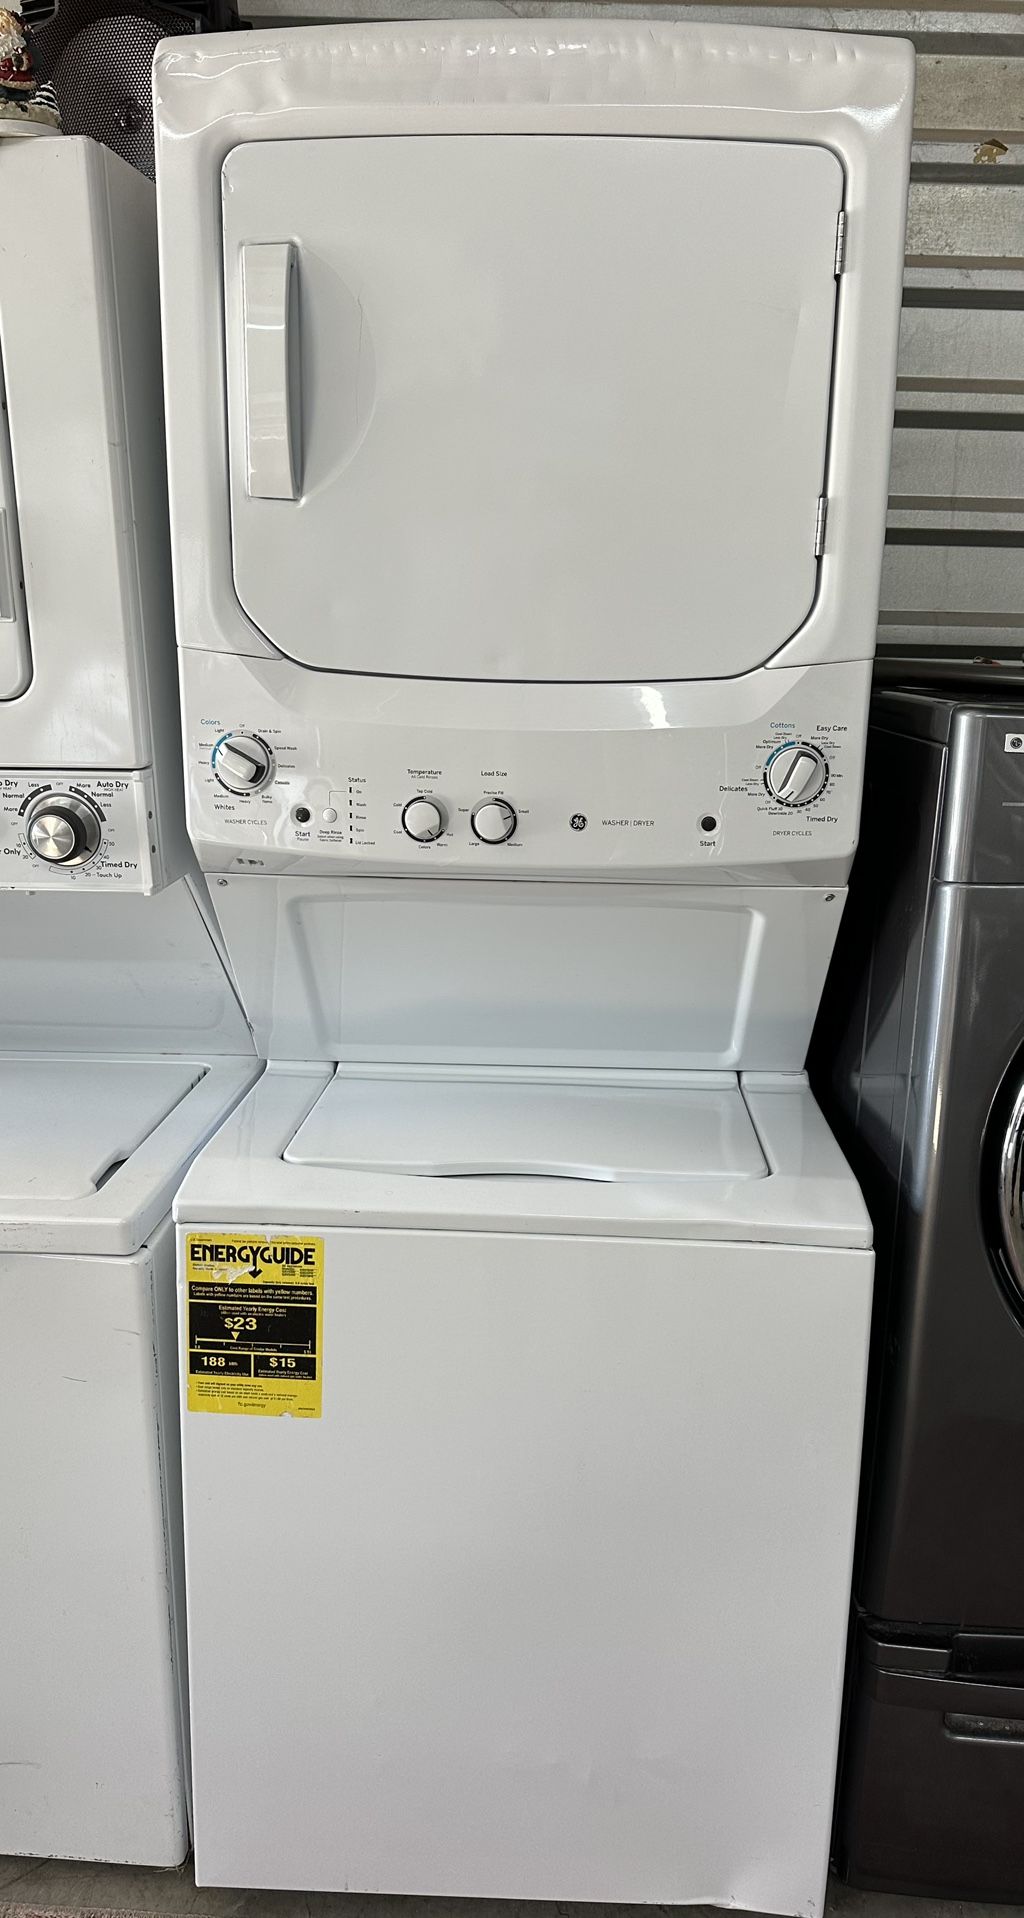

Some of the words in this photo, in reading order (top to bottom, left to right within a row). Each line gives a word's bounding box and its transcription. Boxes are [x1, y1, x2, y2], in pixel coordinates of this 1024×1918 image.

[116, 781, 129, 789] Dry
[4, 848, 21, 856] Only
[190, 1244, 316, 1266] ENERGYGUIDE
[224, 1317, 257, 1330] $23
[201, 1356, 225, 1367] 188
[269, 1357, 296, 1368] $15
